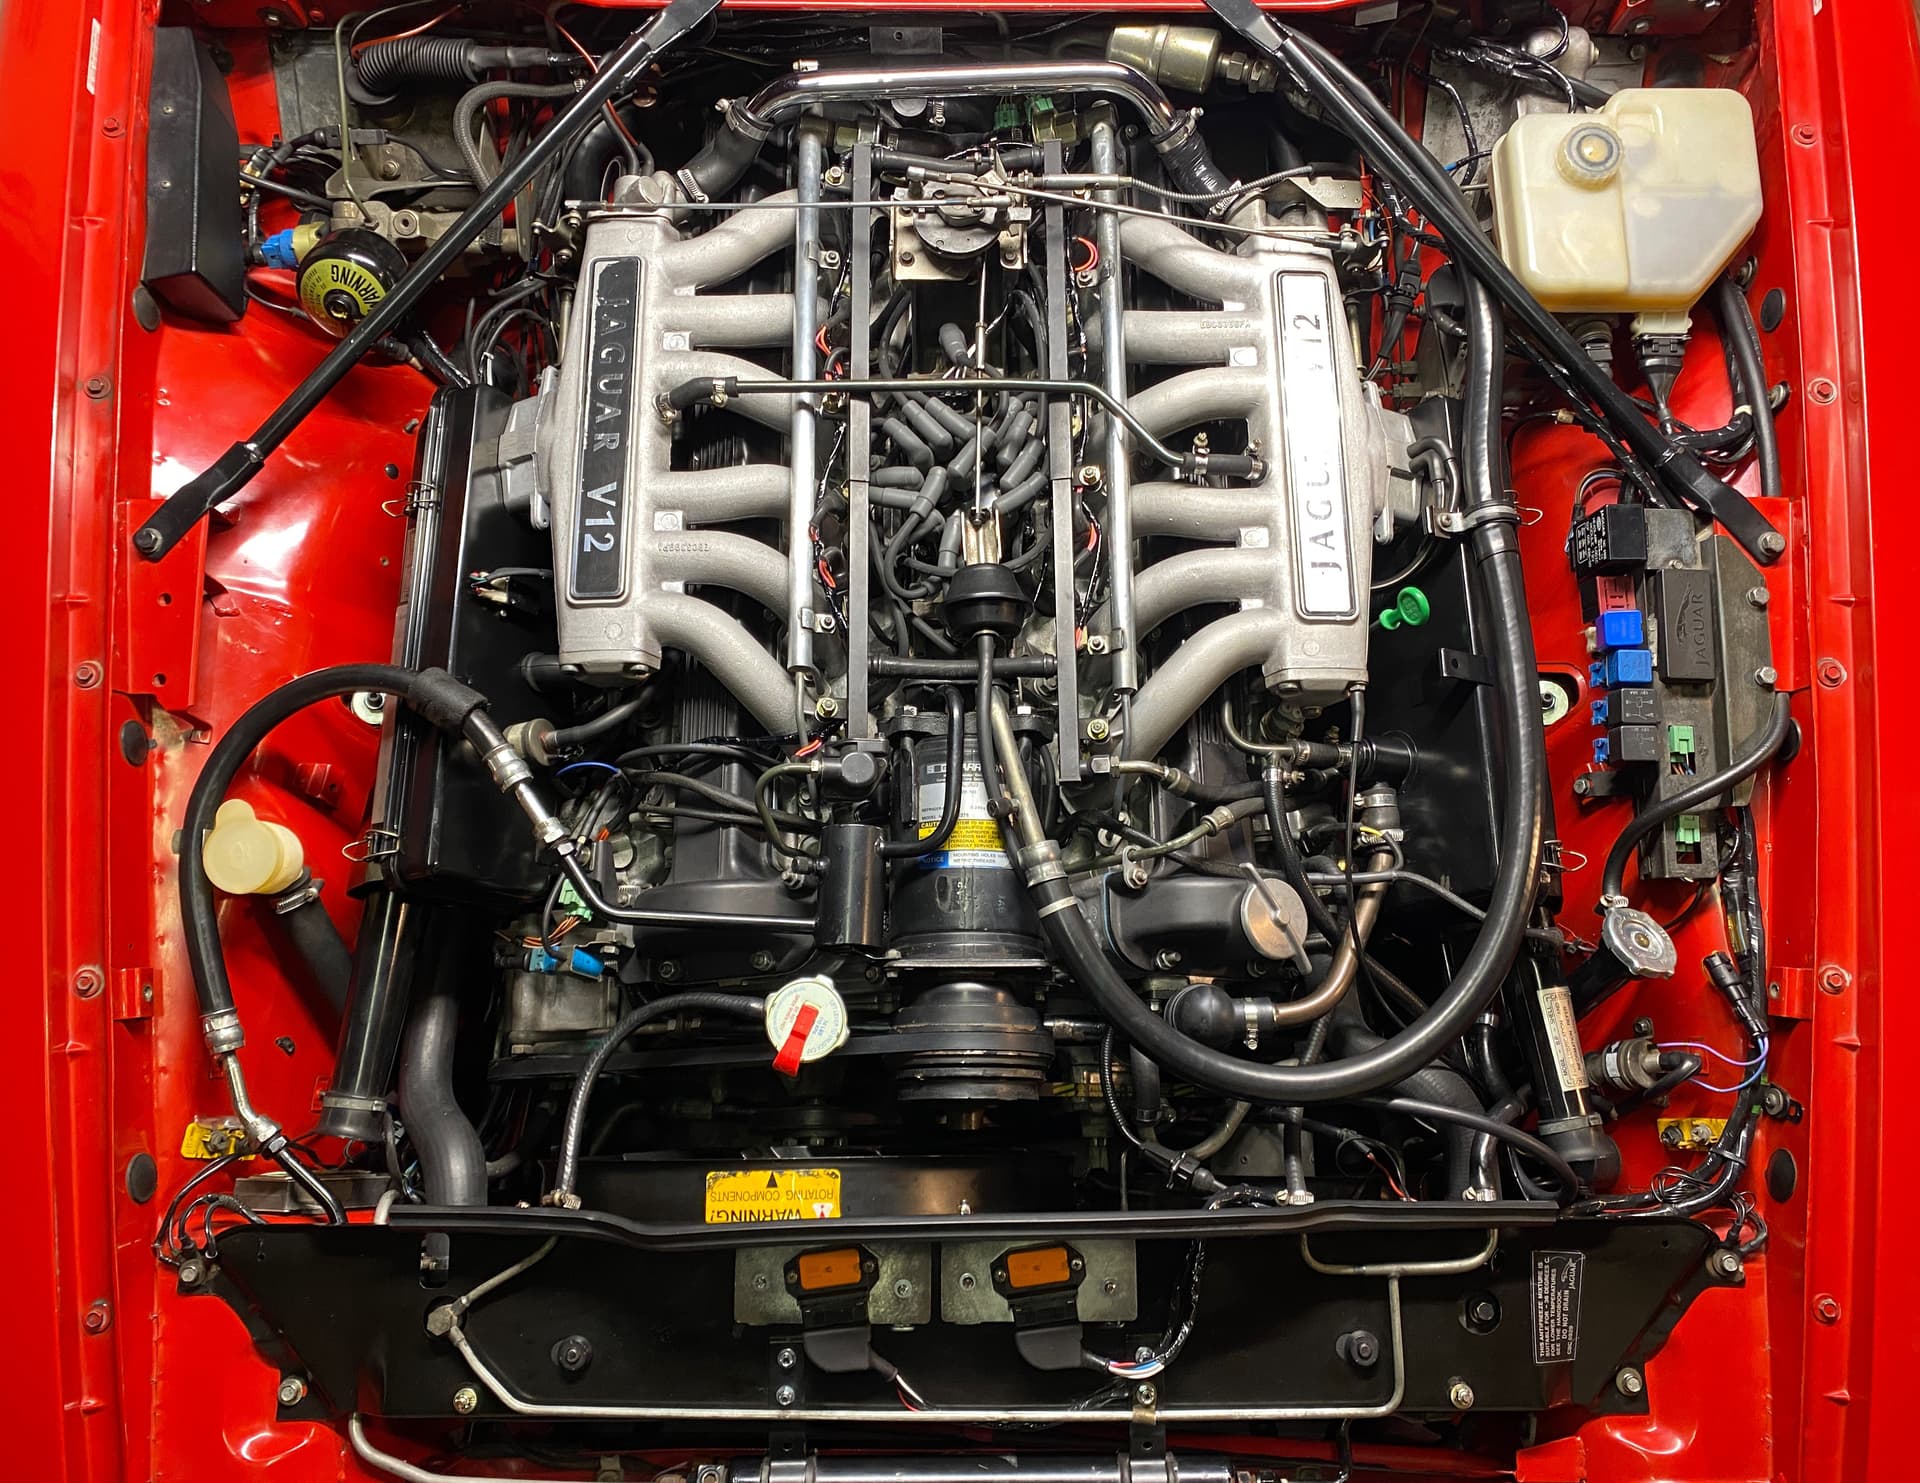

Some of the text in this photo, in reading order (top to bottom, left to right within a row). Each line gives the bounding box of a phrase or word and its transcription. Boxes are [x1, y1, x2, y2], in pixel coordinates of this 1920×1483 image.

[583, 295, 630, 553] JAGUAR V12
[1691, 594, 1710, 666] JAGUAR
[711, 1190, 781, 1202] COMPONENTS
[786, 1189, 834, 1200] ROTATING
[711, 1209, 801, 1222] WARNING!
[1568, 1262, 1576, 1289] JAGUAR
[1562, 1329, 1567, 1339] DO
